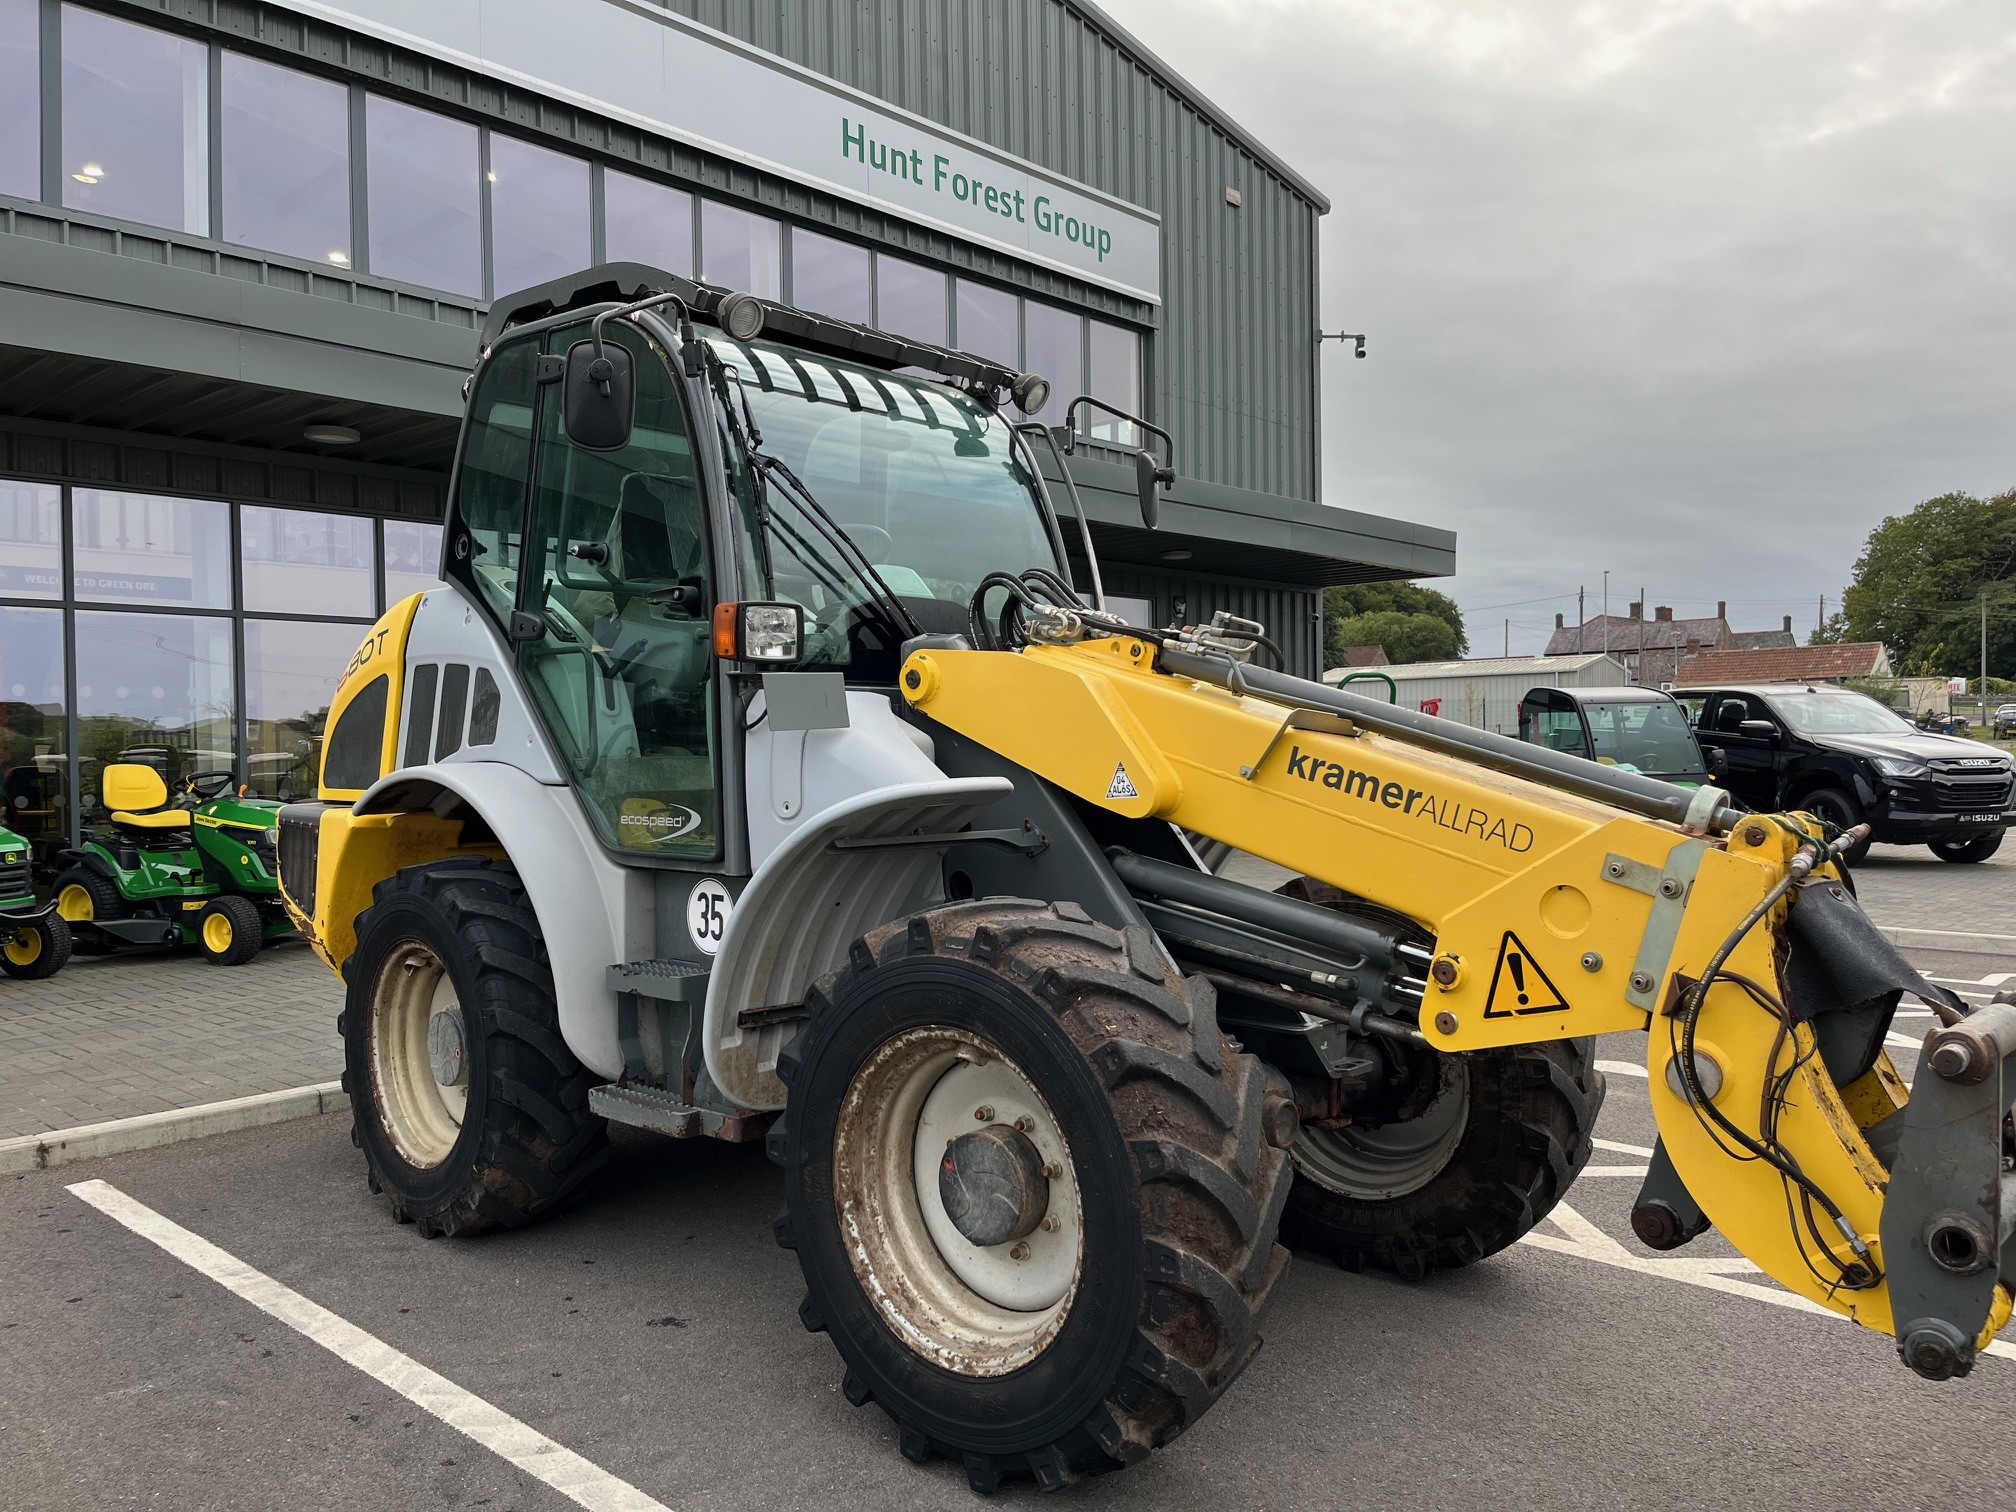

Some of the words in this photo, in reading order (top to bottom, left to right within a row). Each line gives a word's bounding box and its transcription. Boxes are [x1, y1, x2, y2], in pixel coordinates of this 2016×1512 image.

[842, 117, 923, 186] Hunt
[934, 154, 1025, 223] Forest
[1034, 196, 1112, 262] Group
[24, 574, 80, 586] WELCE
[83, 578, 96, 587] TO
[98, 579, 133, 590] GREEN
[1972, 814, 2000, 822] ISUZU
[696, 892, 725, 942] 35
